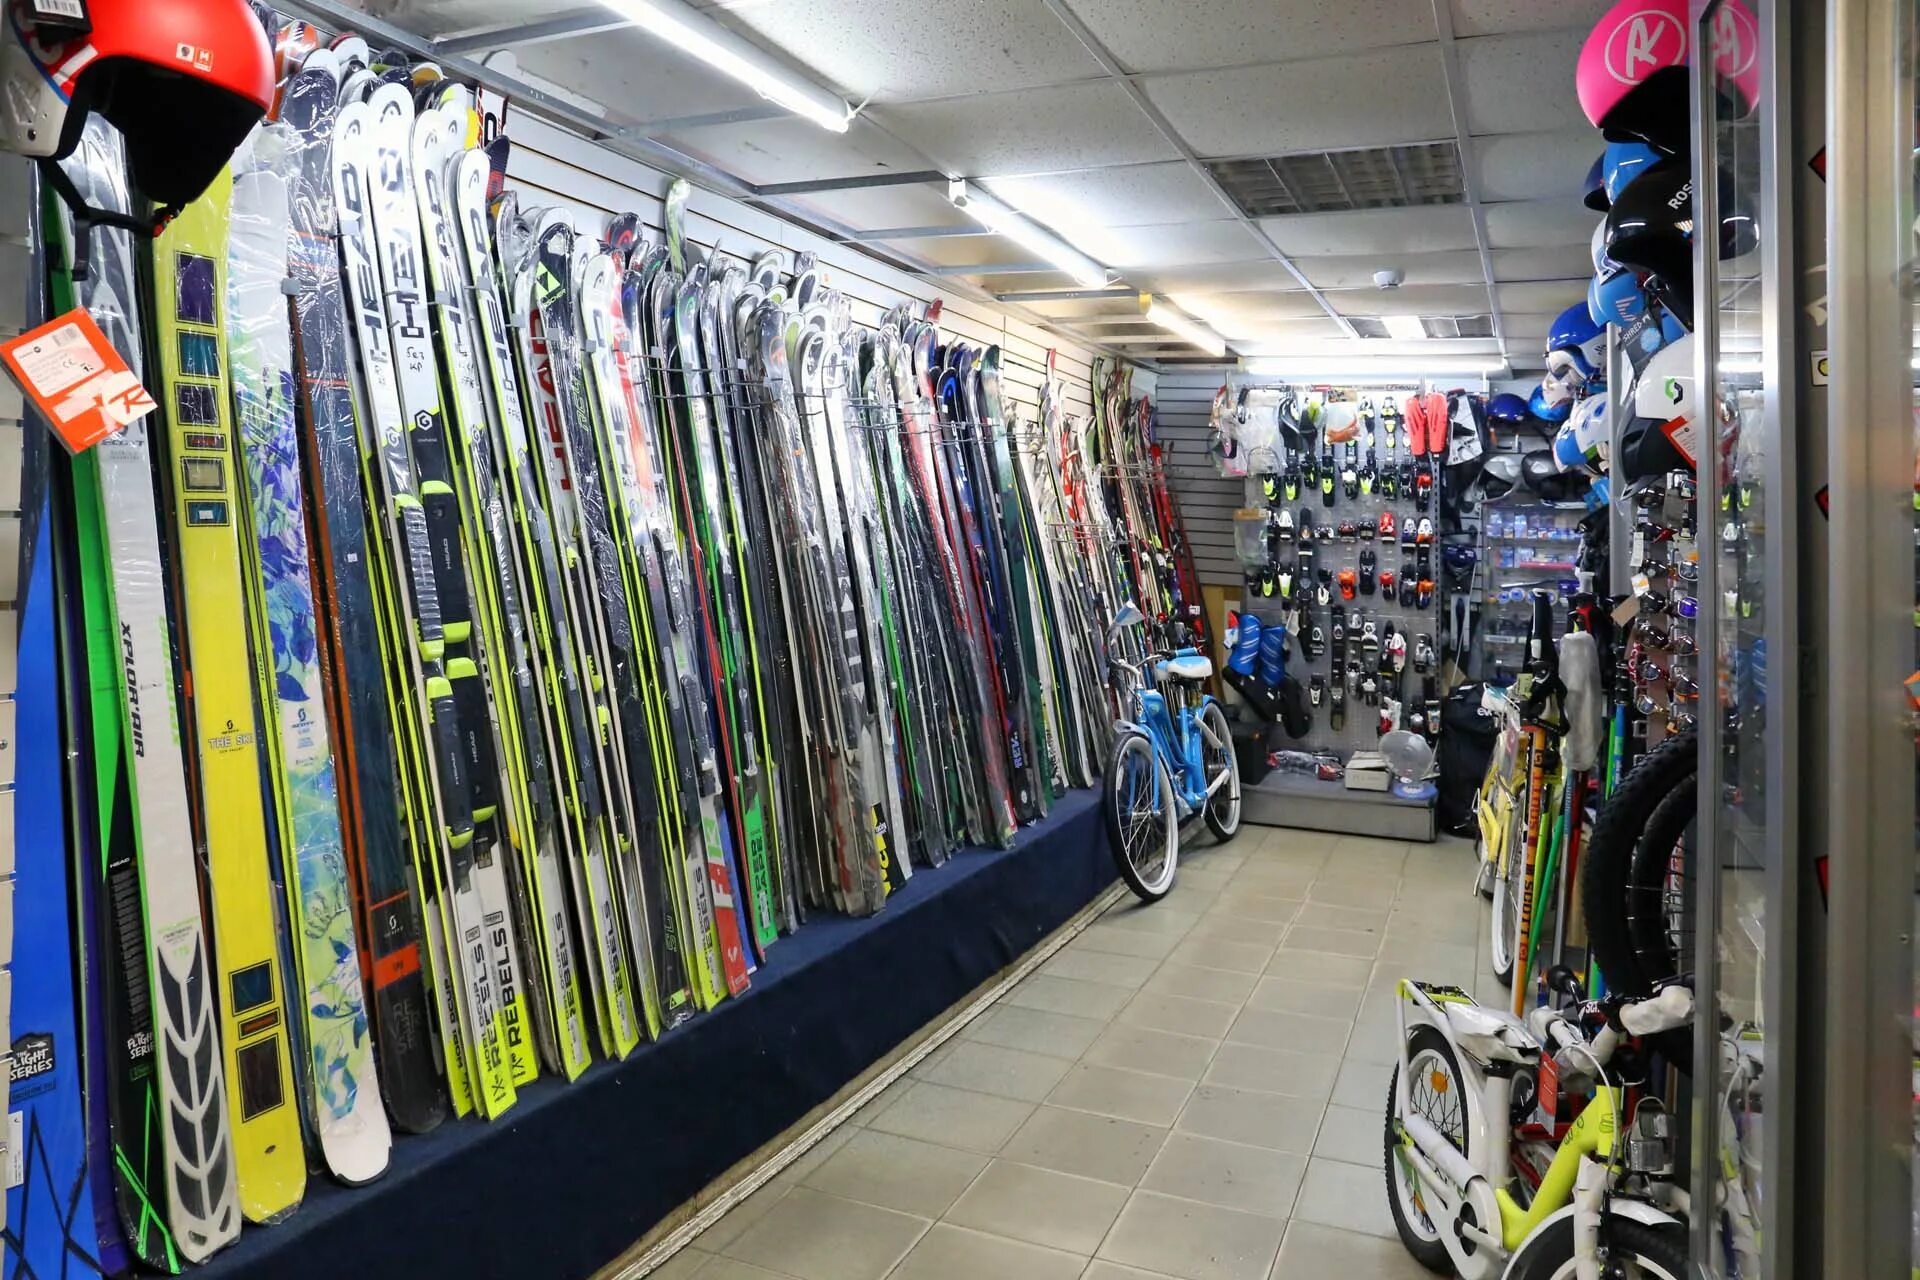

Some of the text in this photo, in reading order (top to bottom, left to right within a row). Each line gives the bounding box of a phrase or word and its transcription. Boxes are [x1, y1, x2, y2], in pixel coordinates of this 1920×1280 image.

[1667, 179, 1692, 210] ROS
[1622, 321, 1644, 344] SHRED
[530, 309, 572, 491] HEAD
[443, 537, 452, 570] HEAD
[208, 734, 231, 750] THE
[469, 730, 479, 763] HEAD
[1521, 878, 1534, 939] SCOTT
[494, 927, 525, 1048] REBELS
[12, 1048, 49, 1068] LIGHT
[130, 1042, 153, 1060] SERI
[11, 1058, 53, 1081] SERIES
